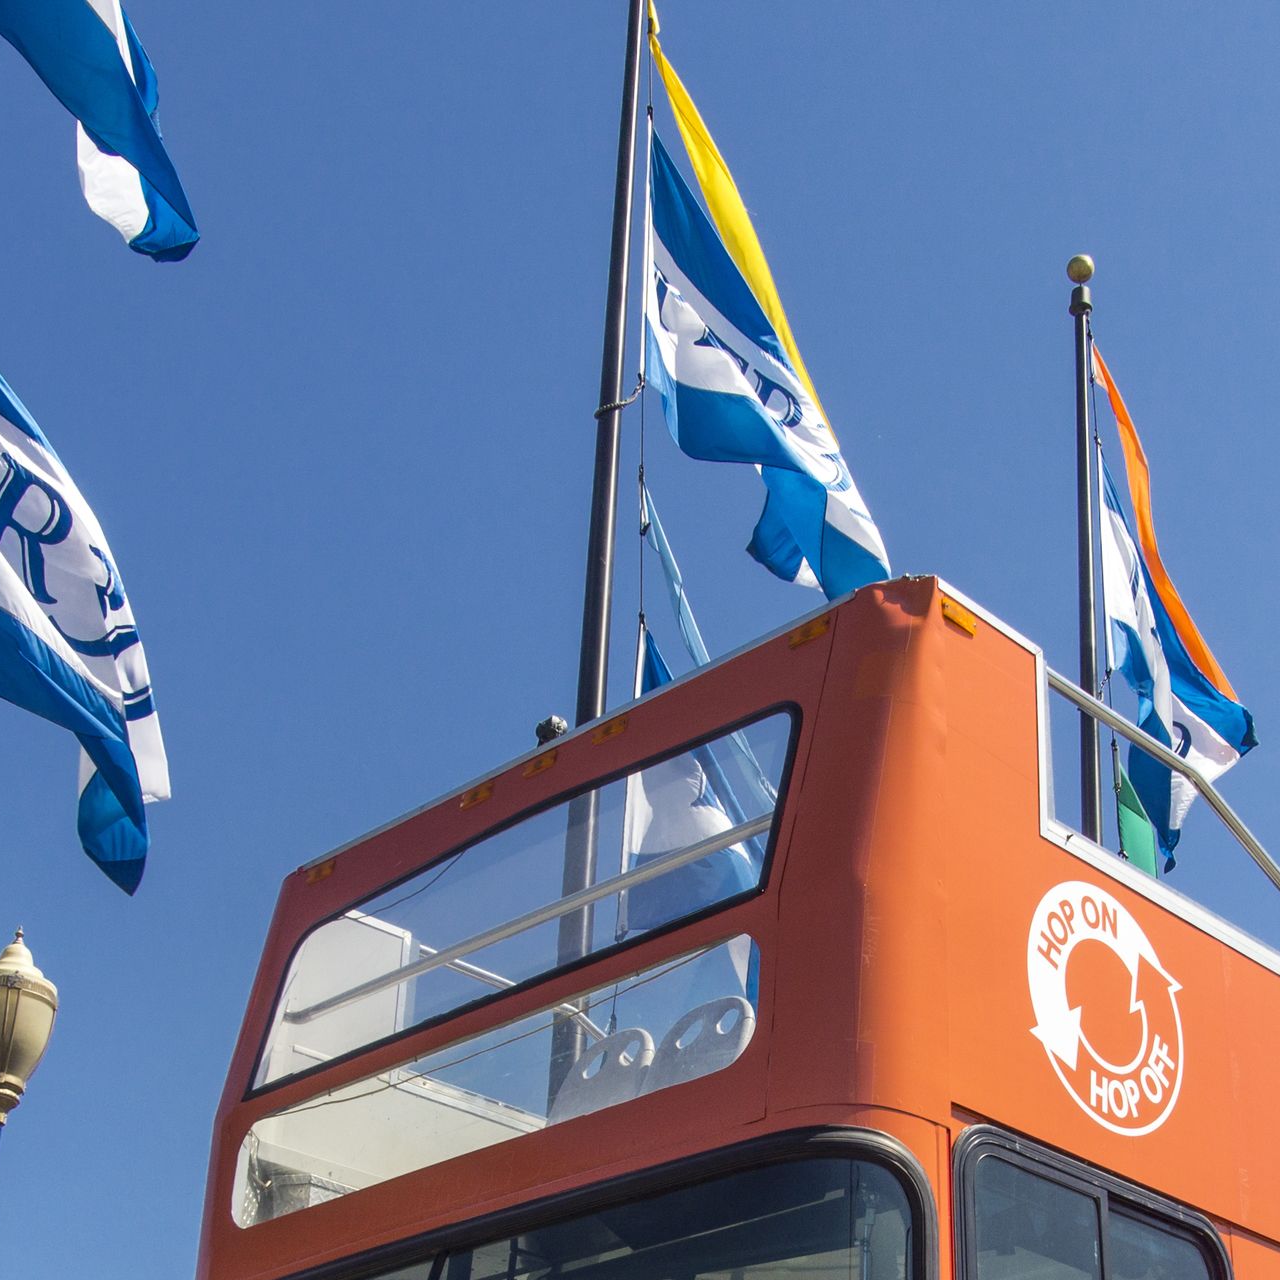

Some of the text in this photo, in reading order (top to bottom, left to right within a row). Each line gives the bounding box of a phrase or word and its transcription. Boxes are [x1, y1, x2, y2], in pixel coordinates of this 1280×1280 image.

[1037, 895, 1118, 971] HOP ON
[1090, 1034, 1176, 1119] HOP OFF
